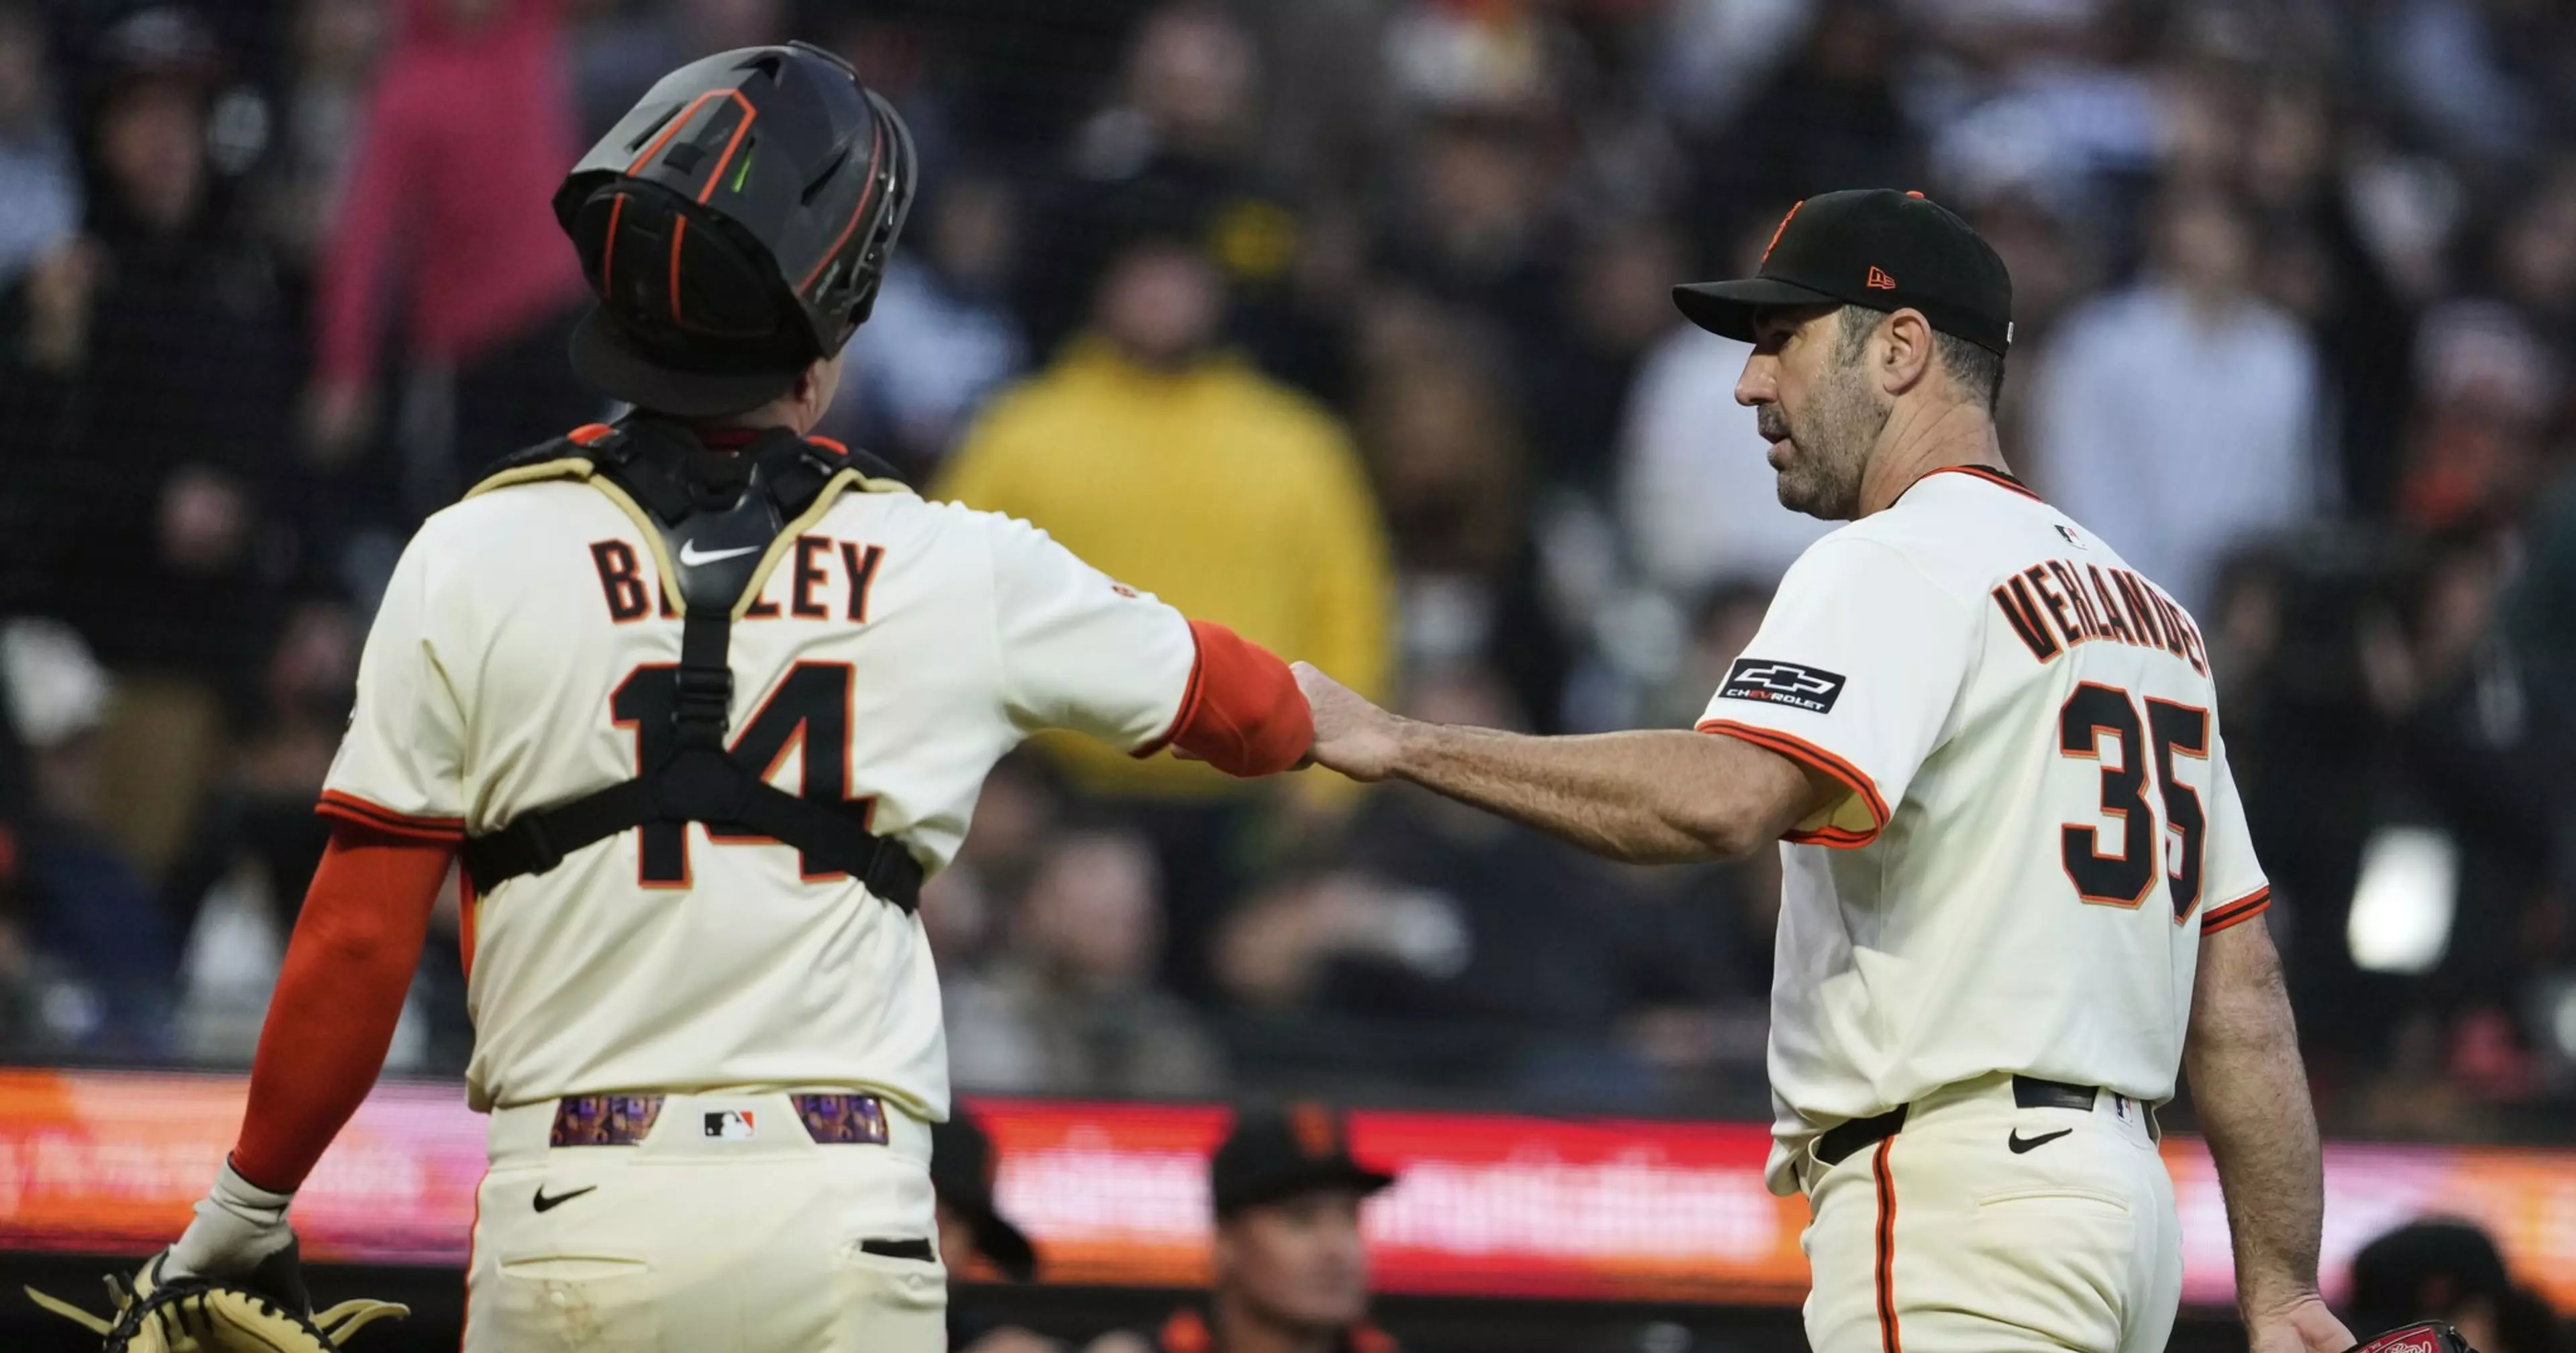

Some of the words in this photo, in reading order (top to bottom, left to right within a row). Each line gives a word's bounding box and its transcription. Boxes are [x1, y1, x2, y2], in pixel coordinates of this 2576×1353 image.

[589, 535, 885, 625] BEY
[1990, 558, 2210, 679] VERLANDE
[1726, 688, 1825, 710] CHEVROLET
[610, 660, 877, 890] 14
[2059, 680, 2210, 926] 35
